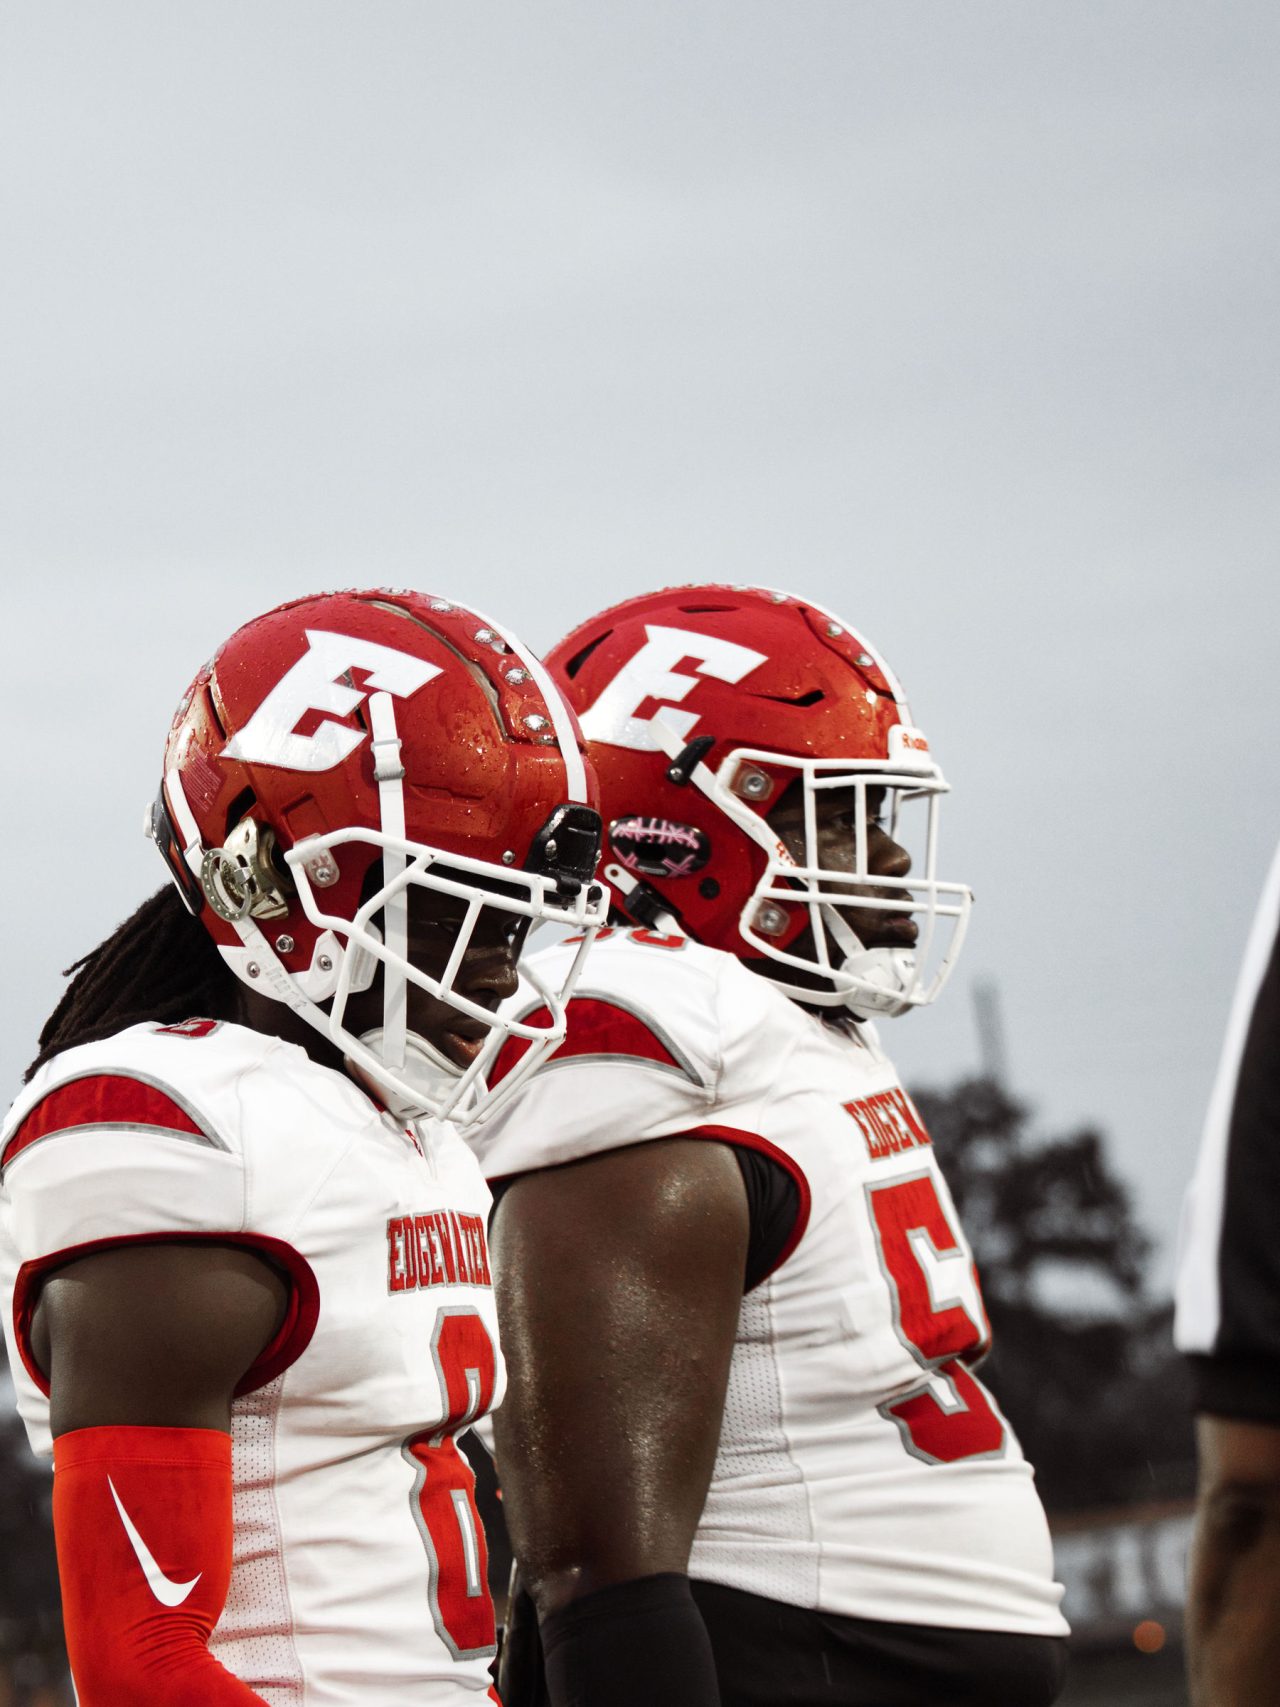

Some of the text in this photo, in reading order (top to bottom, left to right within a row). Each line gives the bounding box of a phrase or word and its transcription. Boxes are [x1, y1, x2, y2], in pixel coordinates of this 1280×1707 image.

[220, 629, 444, 771] E
[582, 624, 768, 751] E
[863, 1167, 1008, 1465] 5
